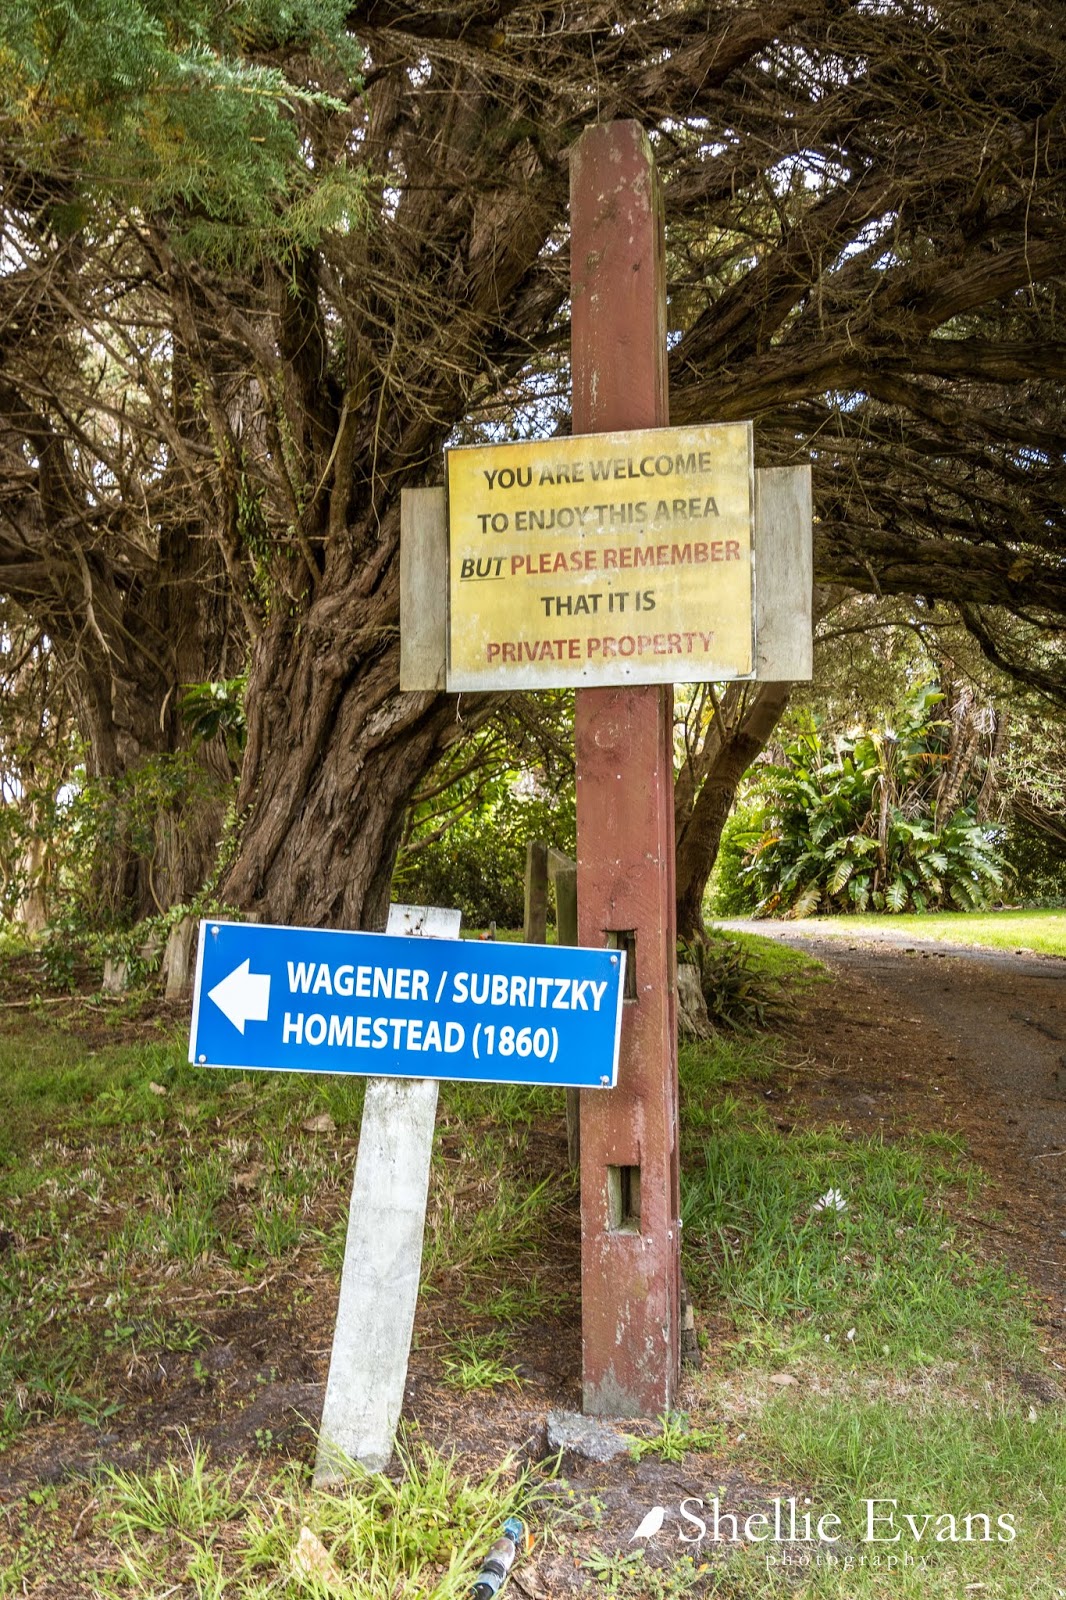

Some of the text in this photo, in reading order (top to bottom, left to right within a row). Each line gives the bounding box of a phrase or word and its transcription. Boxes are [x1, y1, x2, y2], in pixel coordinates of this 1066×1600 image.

[484, 452, 712, 490] YOU ARE WELCOME
[477, 497, 720, 534] TO ENJOY THIS AREA
[460, 540, 741, 580] BUT PLEASE REMEMBER
[540, 590, 657, 617] THAT IT IS
[486, 631, 715, 663] PRIVATE PROPERTY
[287, 961, 608, 1012] WAGENER / SUBRITZKY
[282, 1011, 560, 1063] HOMESTEAD (1860)
